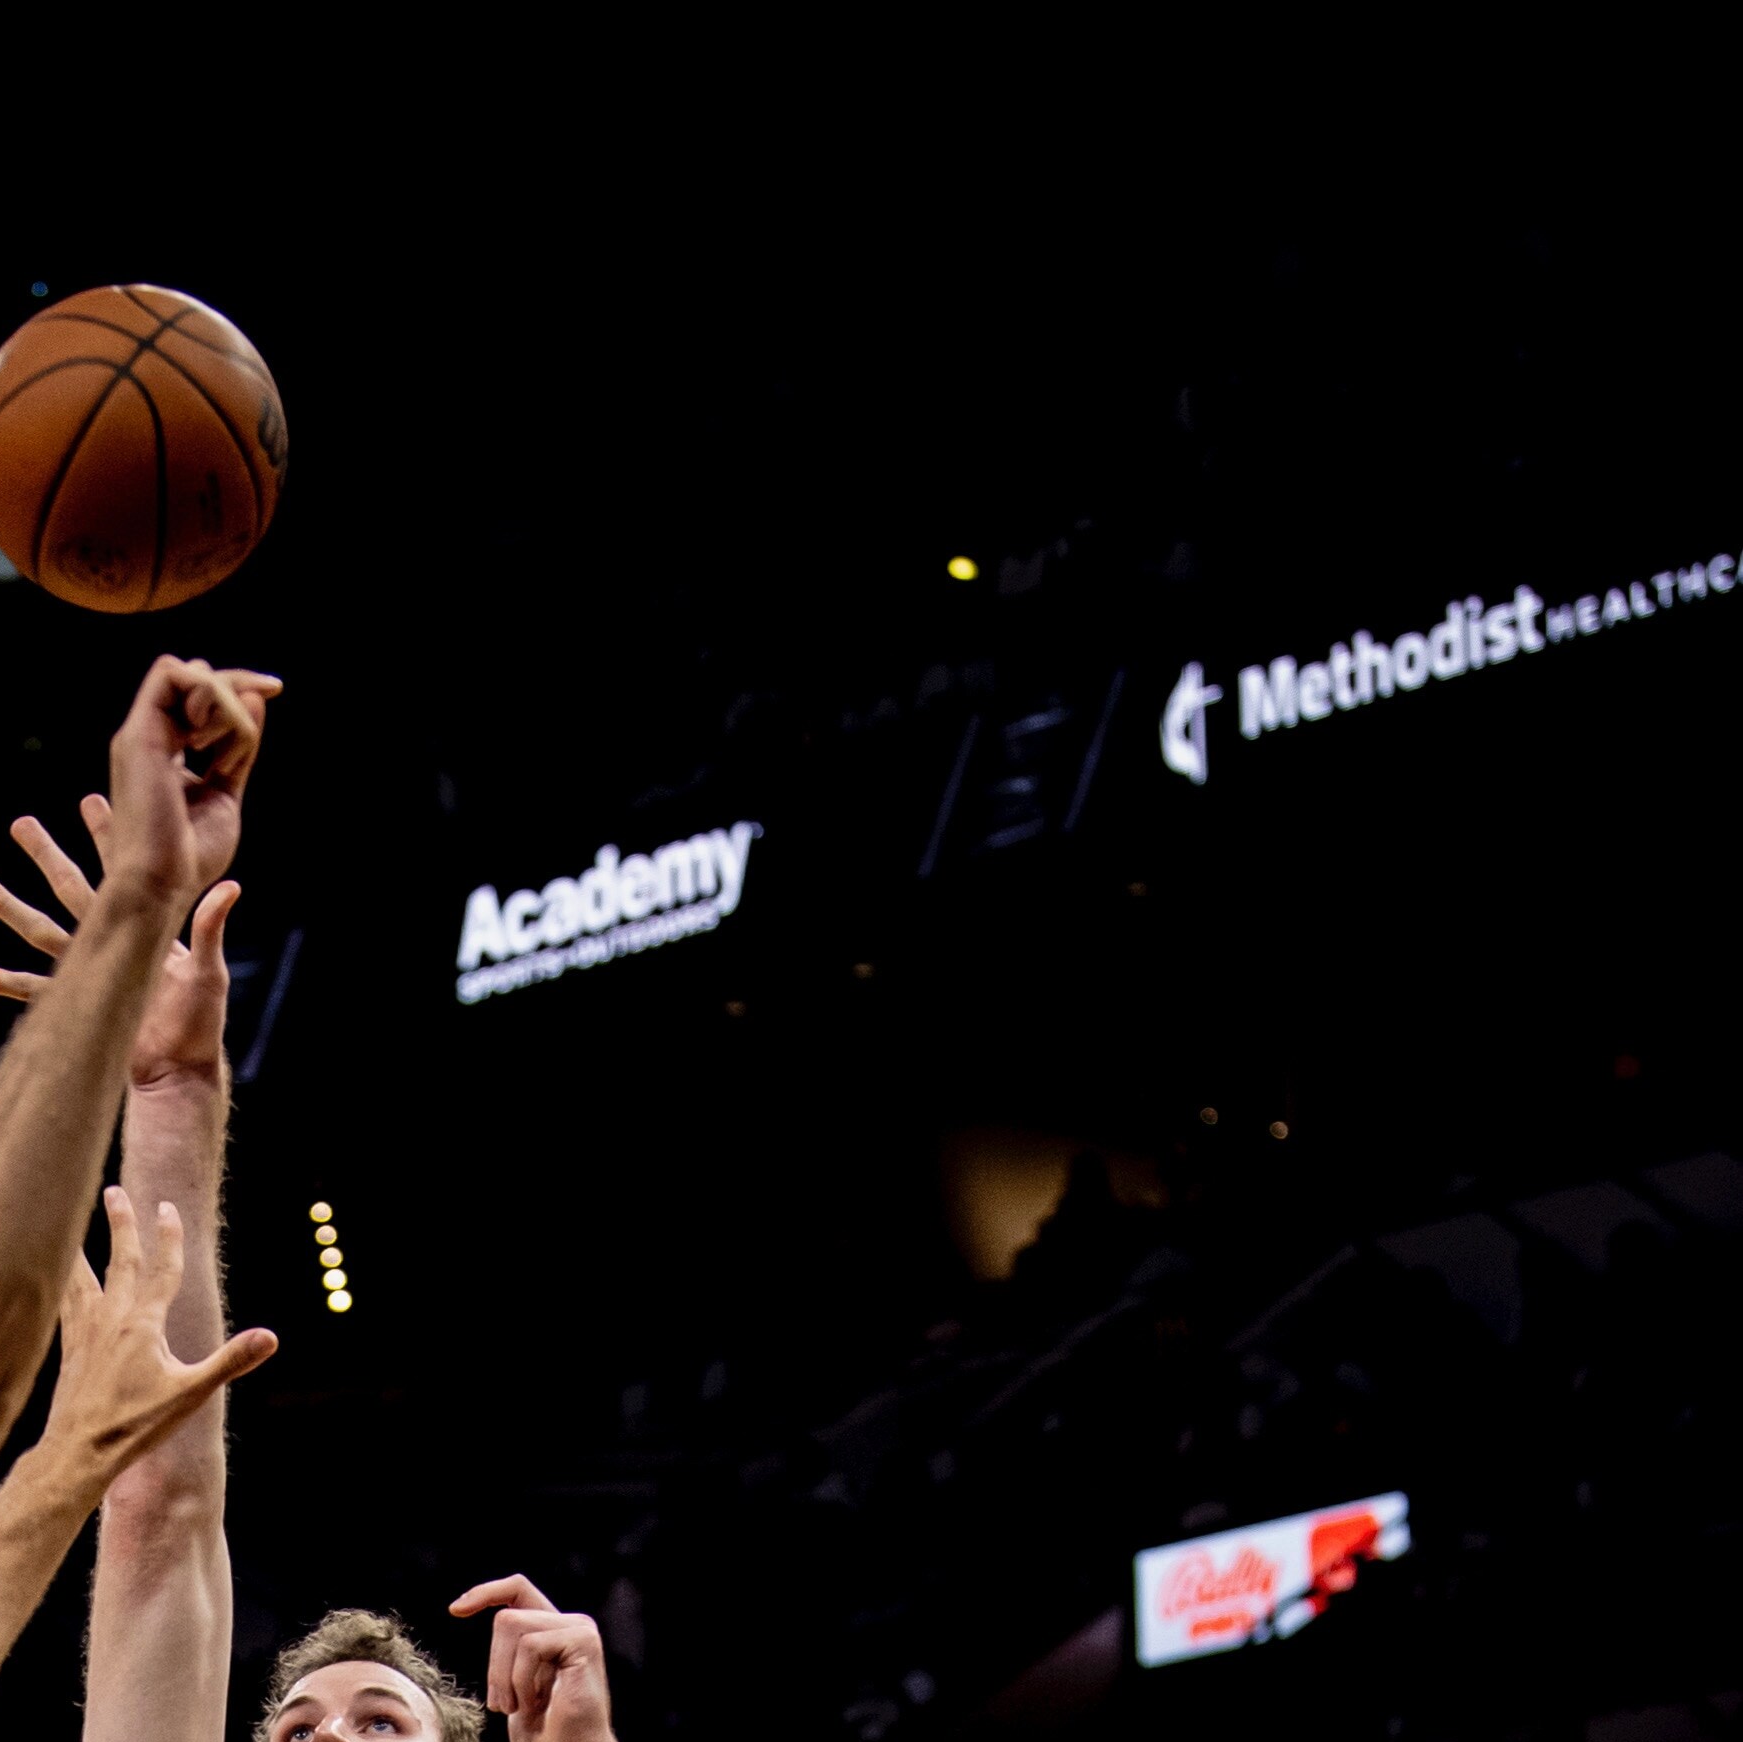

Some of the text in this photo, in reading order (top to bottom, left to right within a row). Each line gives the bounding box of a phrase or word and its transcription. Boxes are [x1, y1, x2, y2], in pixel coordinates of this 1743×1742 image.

[1238, 552, 1743, 740] Methodist HEALTHC
[457, 820, 753, 970] Academy
